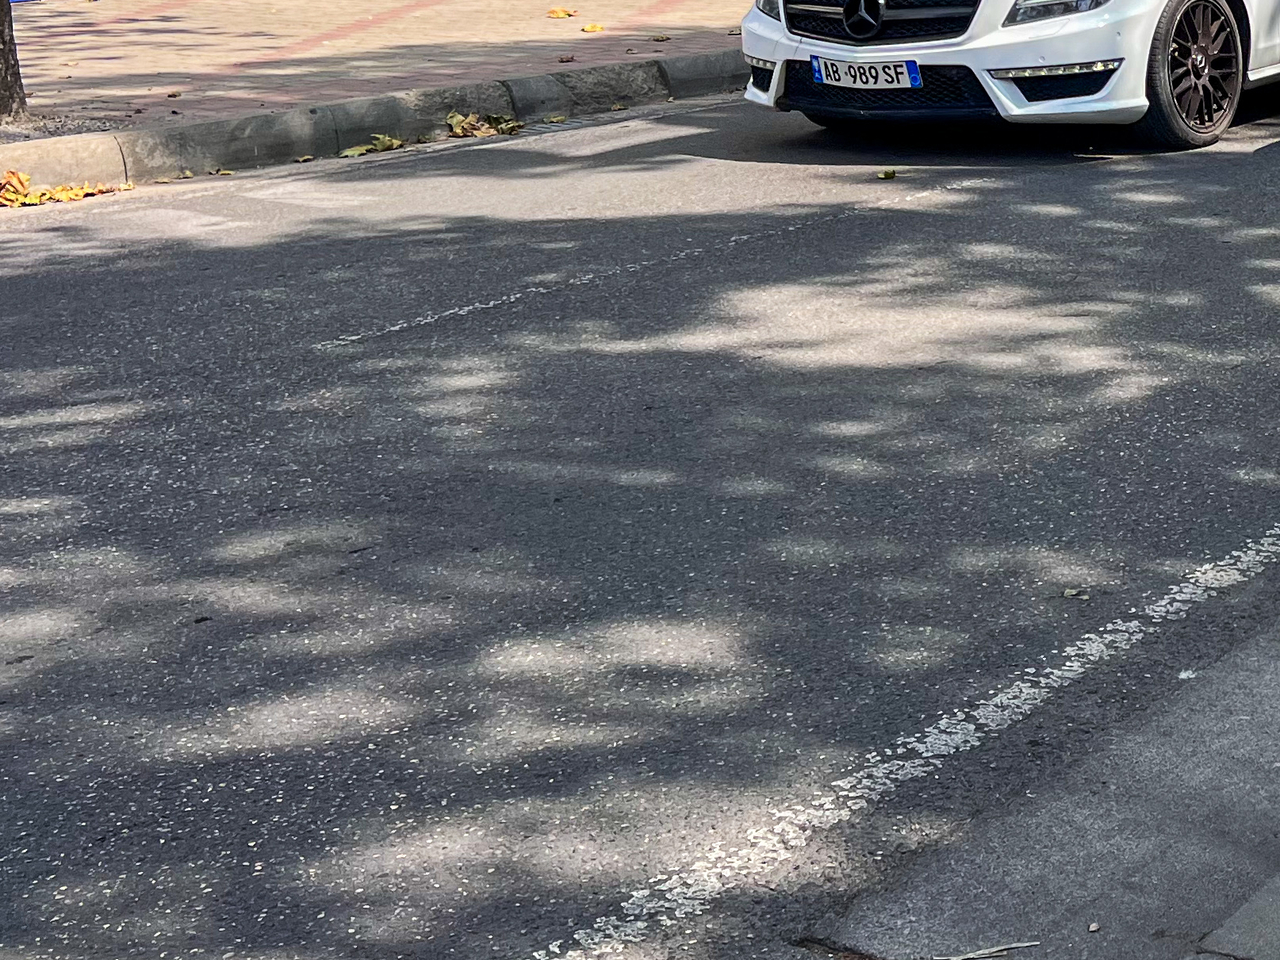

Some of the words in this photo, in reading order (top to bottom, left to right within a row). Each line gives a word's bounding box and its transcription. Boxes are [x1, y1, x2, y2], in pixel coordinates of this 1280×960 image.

[823, 60, 842, 82] AB
[848, 64, 879, 85] 989
[881, 64, 904, 85] SF
